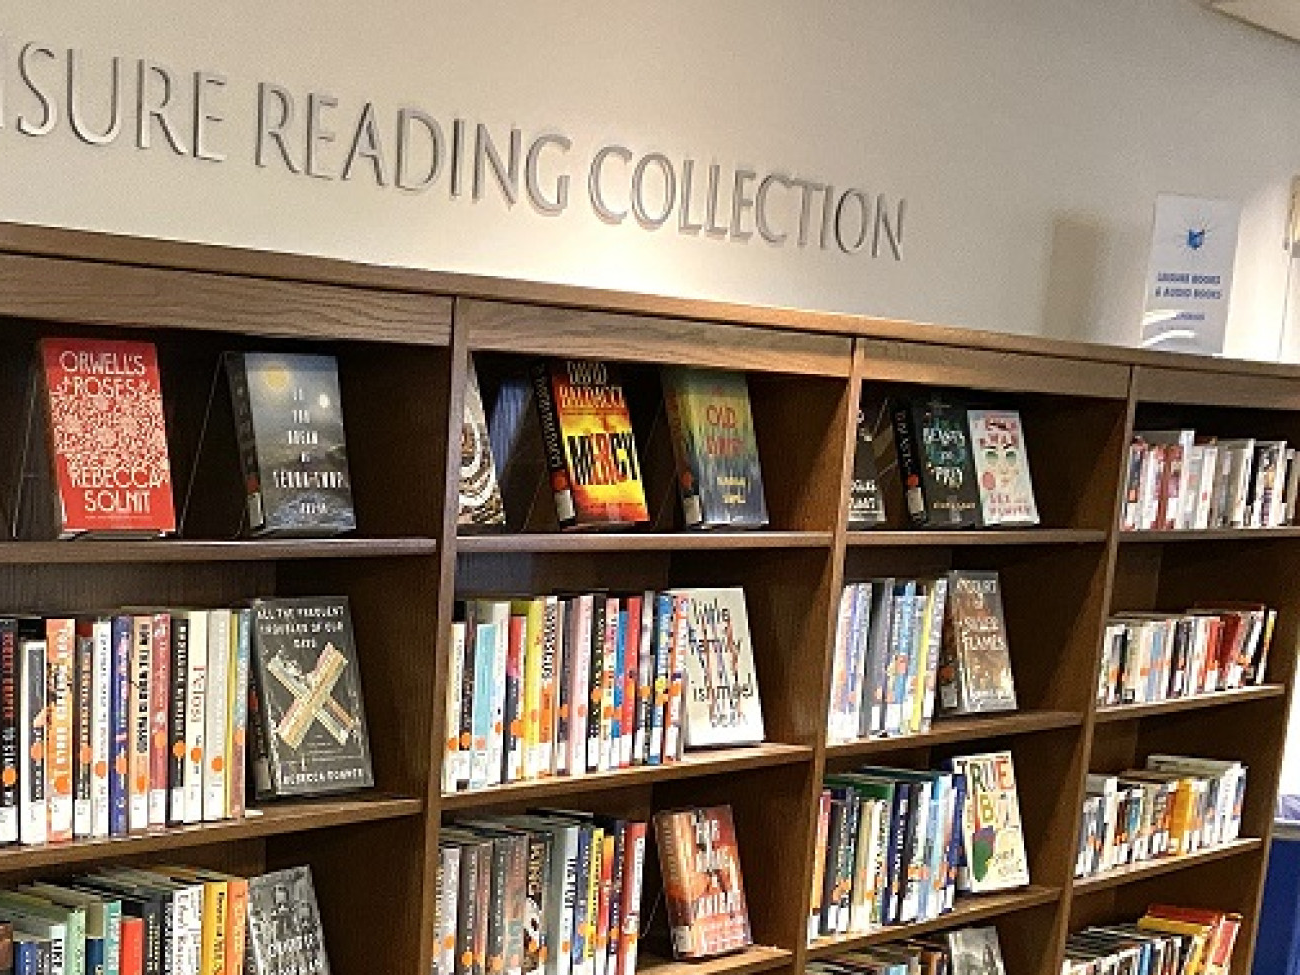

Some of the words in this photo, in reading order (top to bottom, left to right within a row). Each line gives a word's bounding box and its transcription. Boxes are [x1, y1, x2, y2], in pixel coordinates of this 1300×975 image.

[253, 80, 571, 215] READING
[587, 142, 907, 263] COLLECTION
[59, 351, 145, 375] ORWELL'S
[74, 376, 137, 398] ROSES
[566, 432, 638, 486] MERCY
[72, 467, 161, 488] REBECCA
[84, 489, 150, 512] SOLNIT
[190, 666, 206, 724] Pelosi
[956, 757, 1014, 792] TRUE
[525, 841, 544, 898] KING
[177, 893, 190, 930] Ethel
[53, 937, 63, 969] LIKE
